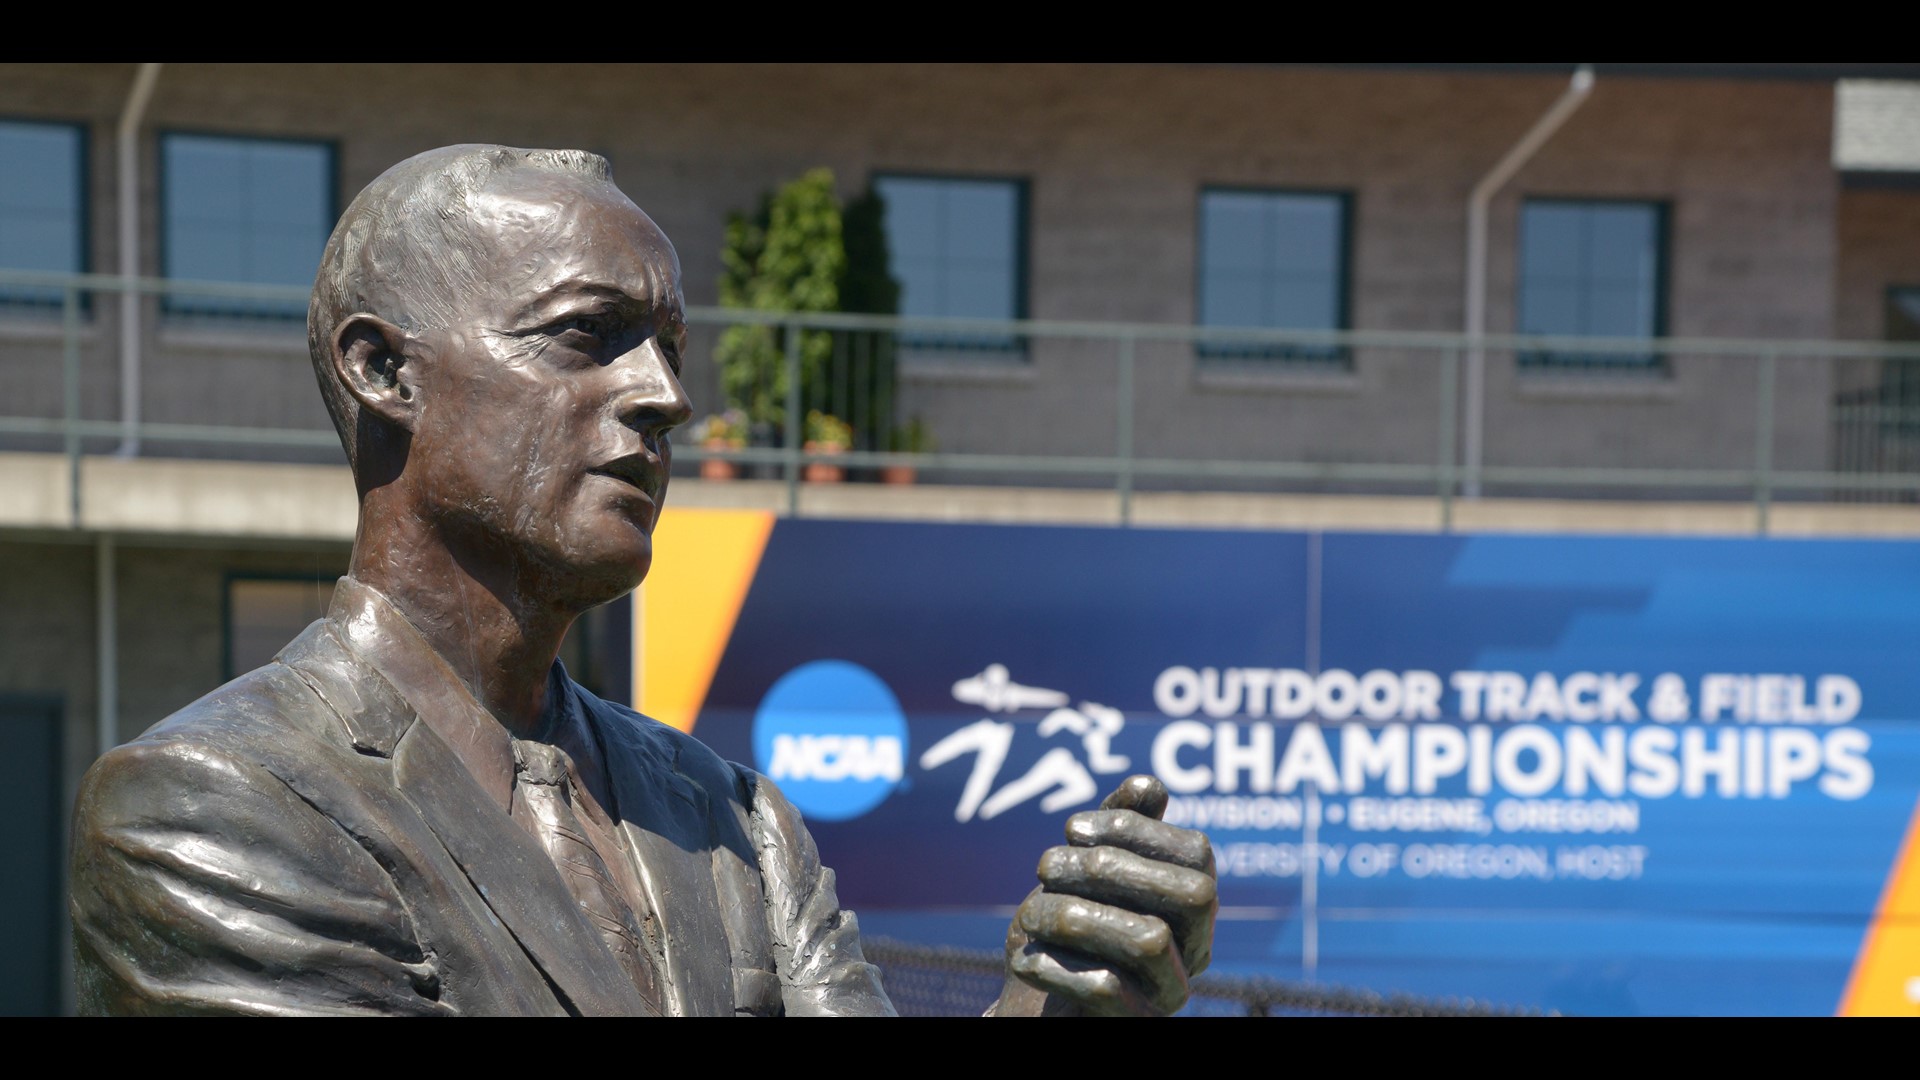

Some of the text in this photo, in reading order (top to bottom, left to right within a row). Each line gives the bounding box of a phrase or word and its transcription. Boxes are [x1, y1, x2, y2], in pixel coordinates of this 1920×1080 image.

[1154, 667, 1862, 725] OUTDOOR TRACK & FIELD
[770, 733, 903, 782] NCAA
[1152, 720, 1874, 800] CHAMPIONSHIPS
[1348, 797, 1492, 836] EUGENE,
[1494, 799, 1640, 834] OREGON
[1212, 842, 1649, 882] VERSITY OF OREGON, HOST
